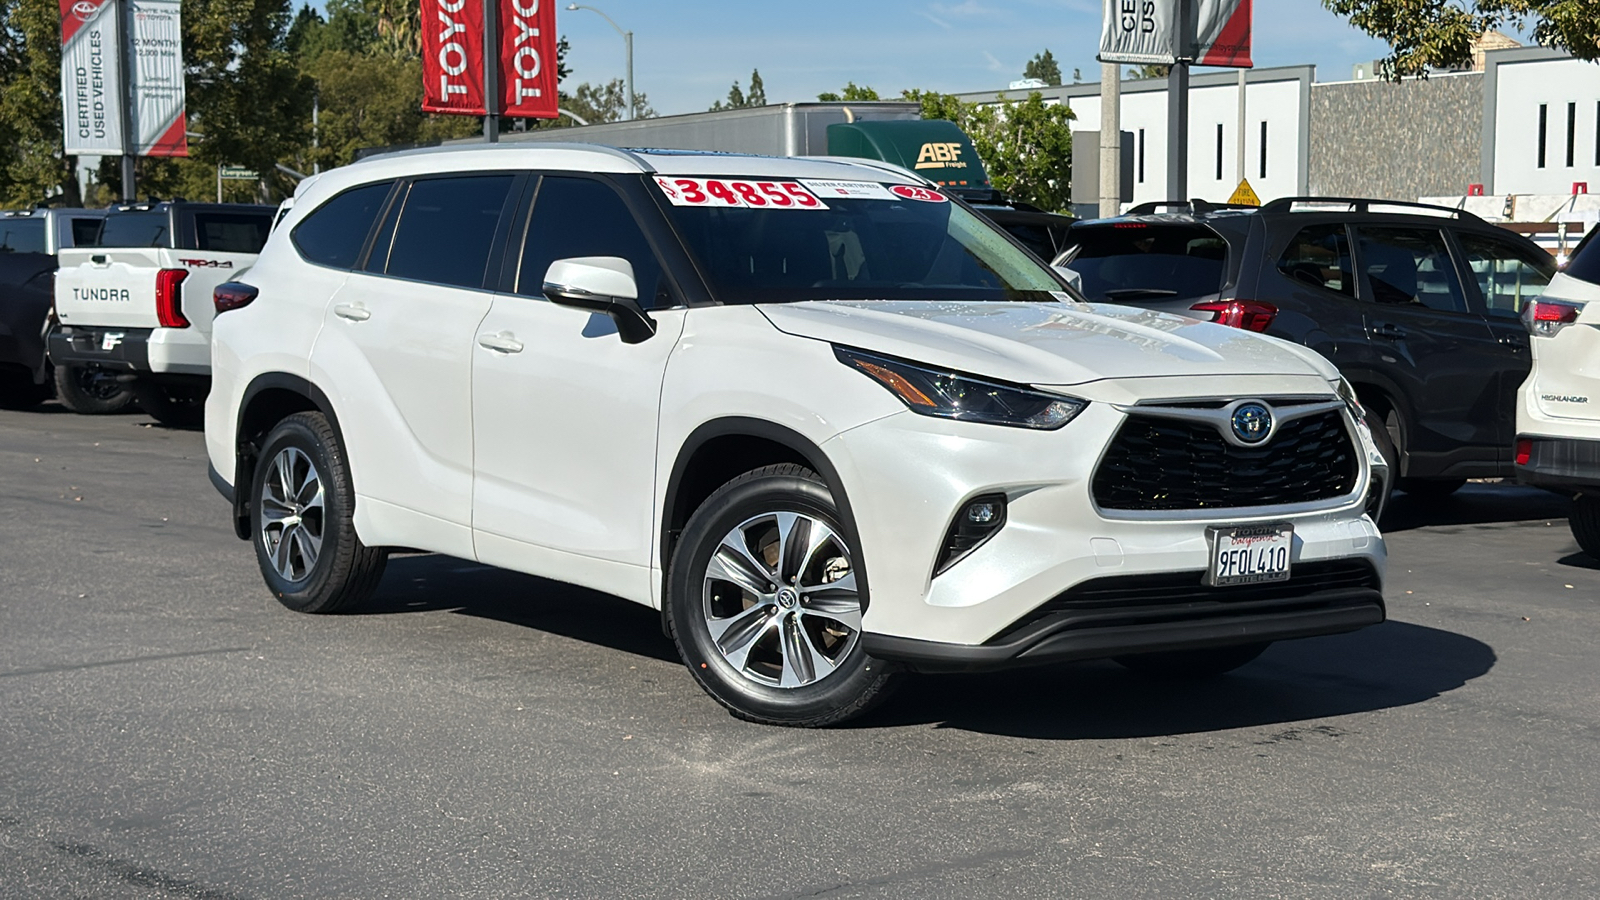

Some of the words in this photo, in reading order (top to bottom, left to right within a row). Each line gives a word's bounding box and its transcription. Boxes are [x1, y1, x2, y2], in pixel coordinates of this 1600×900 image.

[91, 30, 103, 98] VEHICLES
[77, 67, 89, 138] CERTIFIED
[94, 104, 106, 138] USED
[917, 143, 962, 162] ABF
[945, 161, 967, 169] Freight
[73, 288, 130, 302] TUNDRA
[1541, 395, 1589, 404] HIGHLANDER
[1237, 527, 1276, 536] TOYOTA
[1220, 547, 1286, 576] 9FOL410
